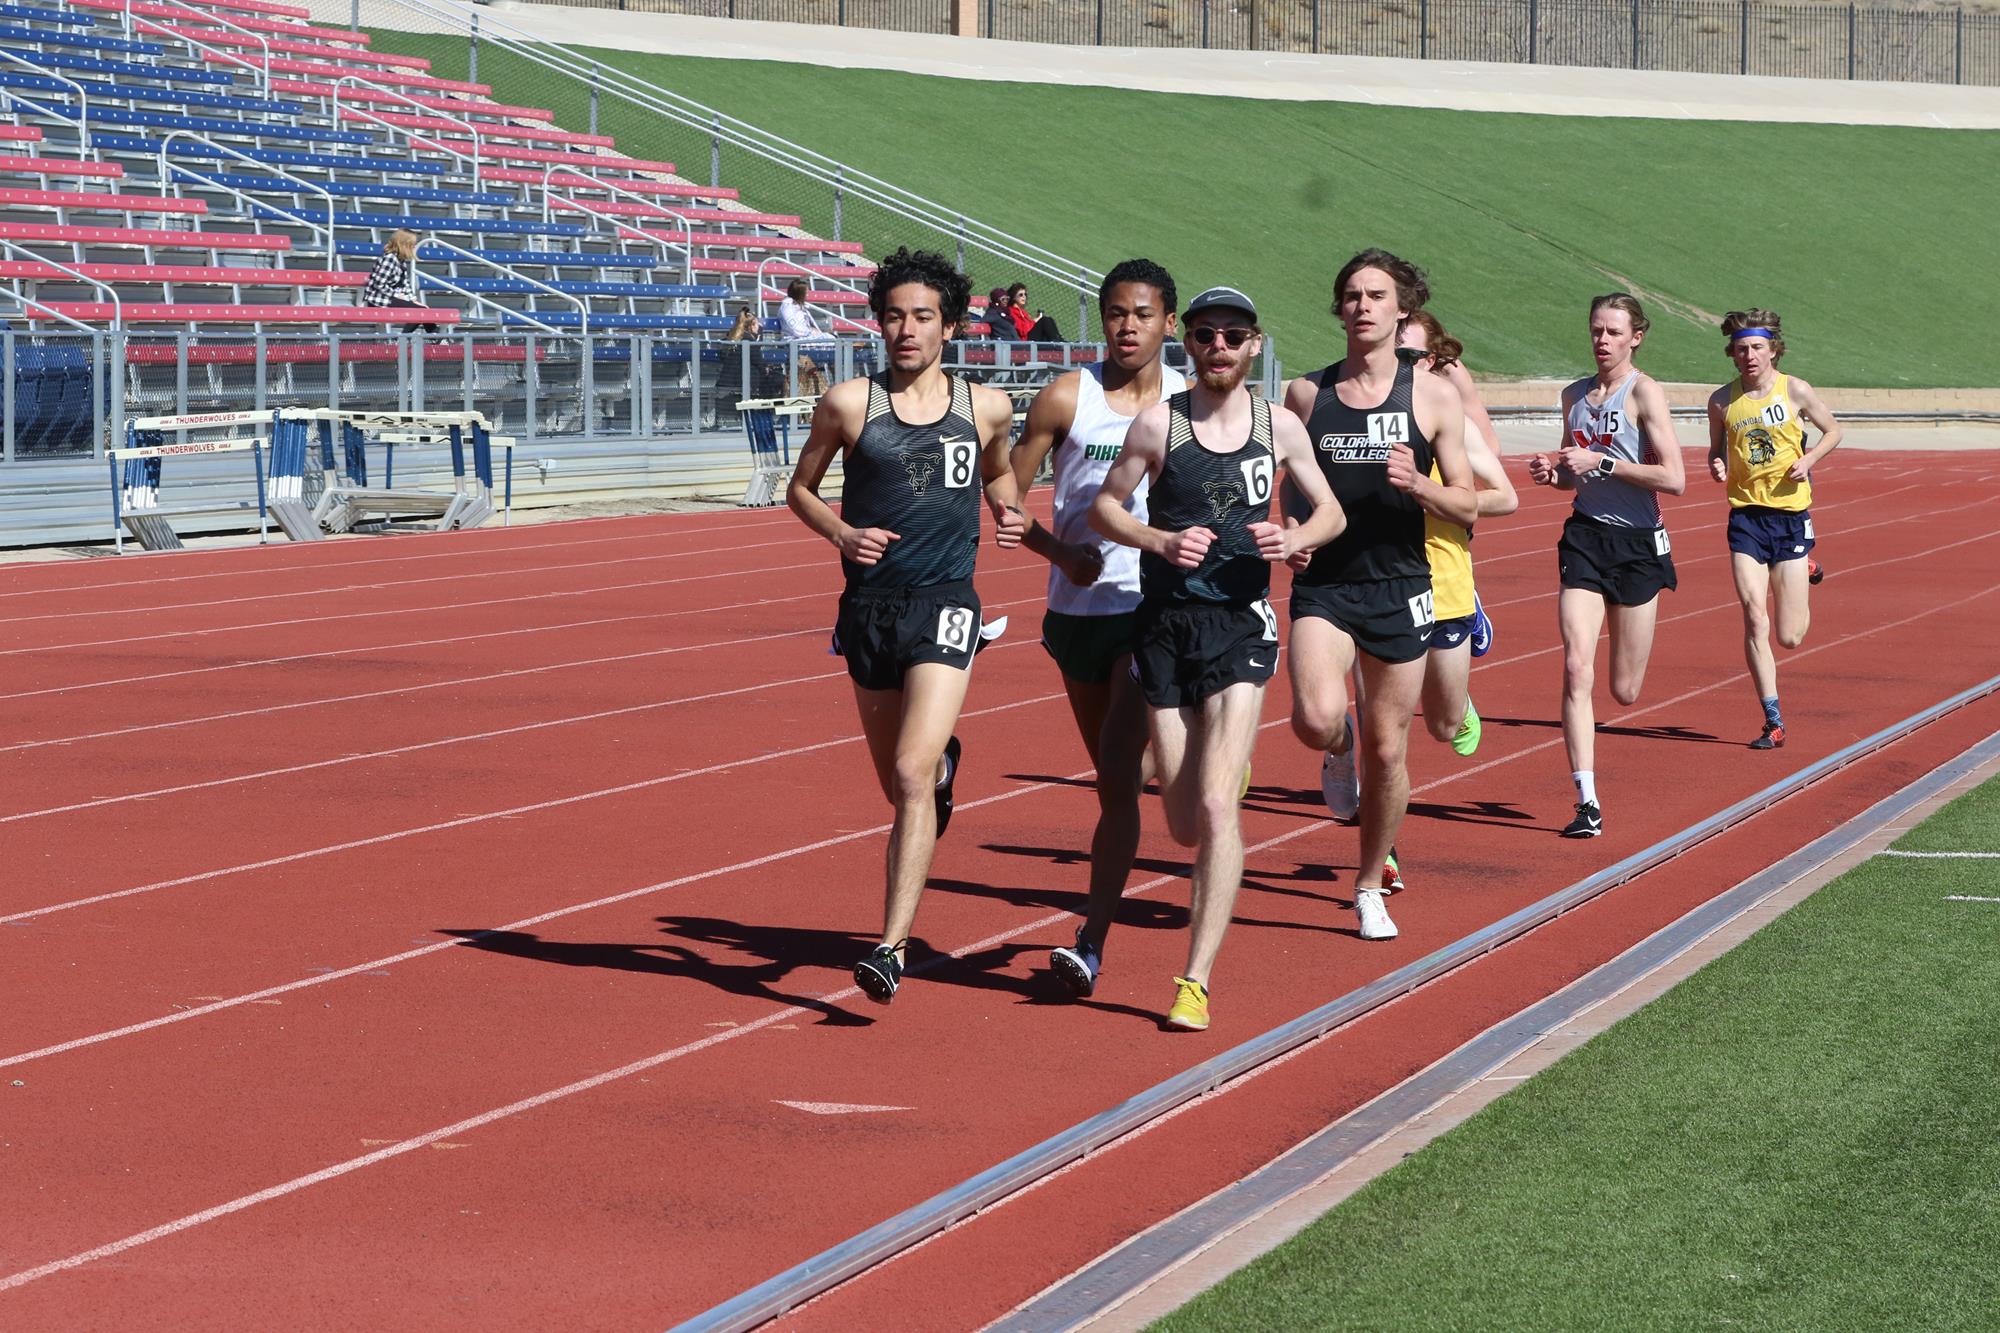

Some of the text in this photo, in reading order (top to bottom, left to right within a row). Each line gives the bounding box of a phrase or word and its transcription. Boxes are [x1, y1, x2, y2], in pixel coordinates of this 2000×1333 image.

[176, 413, 236, 424] THUNDERWOLVES
[1603, 411, 1618, 433] 15
[1766, 404, 1784, 423] 10
[1375, 415, 1402, 441] 14
[157, 443, 215, 455] THUNDERWOLVES
[1335, 449, 1390, 460] COLLEGE
[952, 445, 970, 485] 8
[1252, 459, 1269, 499] 6
[945, 610, 966, 645] 8
[1261, 600, 1276, 637] 6
